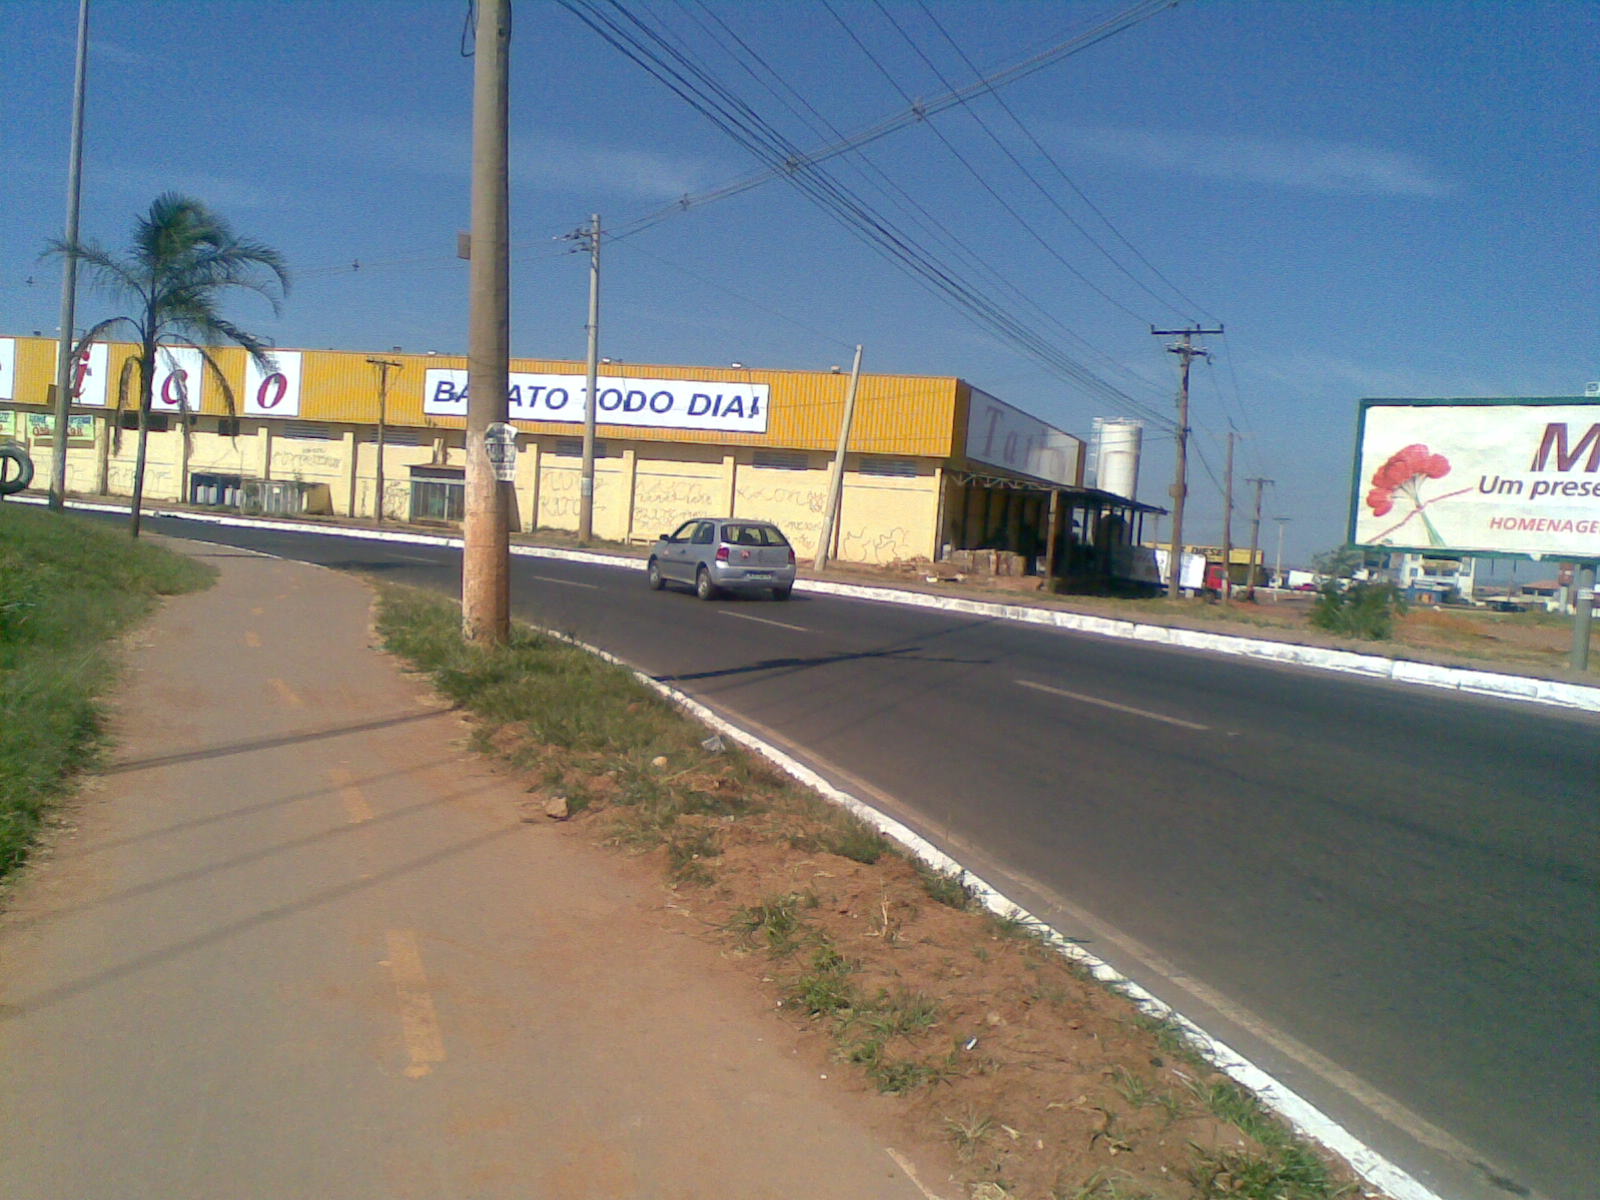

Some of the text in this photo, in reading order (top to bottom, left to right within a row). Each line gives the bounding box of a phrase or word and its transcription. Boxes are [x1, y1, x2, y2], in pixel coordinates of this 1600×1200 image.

[433, 380, 760, 419] BAATO ODO DIA!
[1479, 475, 1600, 500] Um prese
[1490, 516, 1600, 534] HOMENAGE
